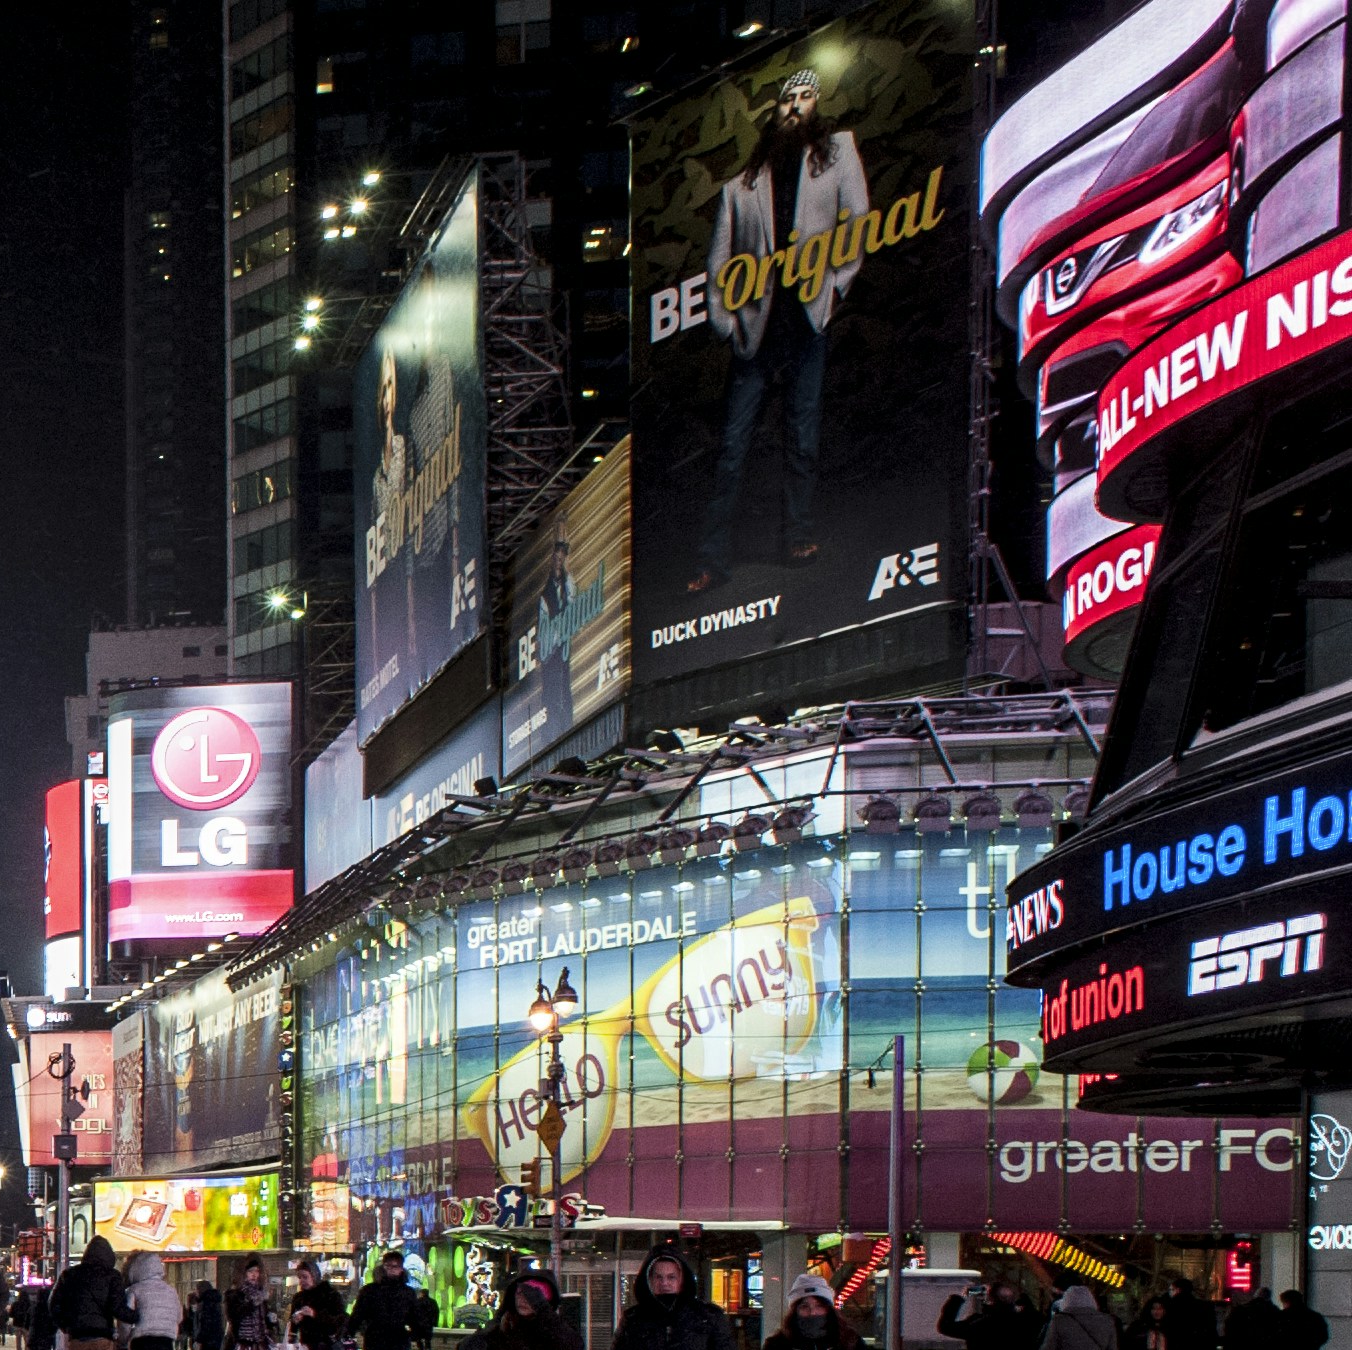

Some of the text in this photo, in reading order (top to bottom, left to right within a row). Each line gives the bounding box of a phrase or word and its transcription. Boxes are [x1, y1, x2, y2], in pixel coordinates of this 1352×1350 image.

[650, 165, 946, 344] BE Original
[1098, 310, 1248, 461] ALL-NEW
[366, 402, 461, 589] BE Original
[450, 558, 476, 631] A&E
[869, 542, 939, 600] A&E
[651, 596, 781, 649] DUCK DYNASTY
[519, 626, 536, 680] BE
[161, 817, 247, 866] LG
[1104, 823, 1247, 911] House
[467, 917, 536, 949] greater
[480, 912, 696, 967] FORT LAUDERDALE
[1188, 913, 1326, 997] ESPN
[235, 998, 252, 1028] ANY
[1050, 979, 1068, 1040] of
[1071, 962, 1144, 1031] union
[1000, 1131, 1196, 1182] greater
